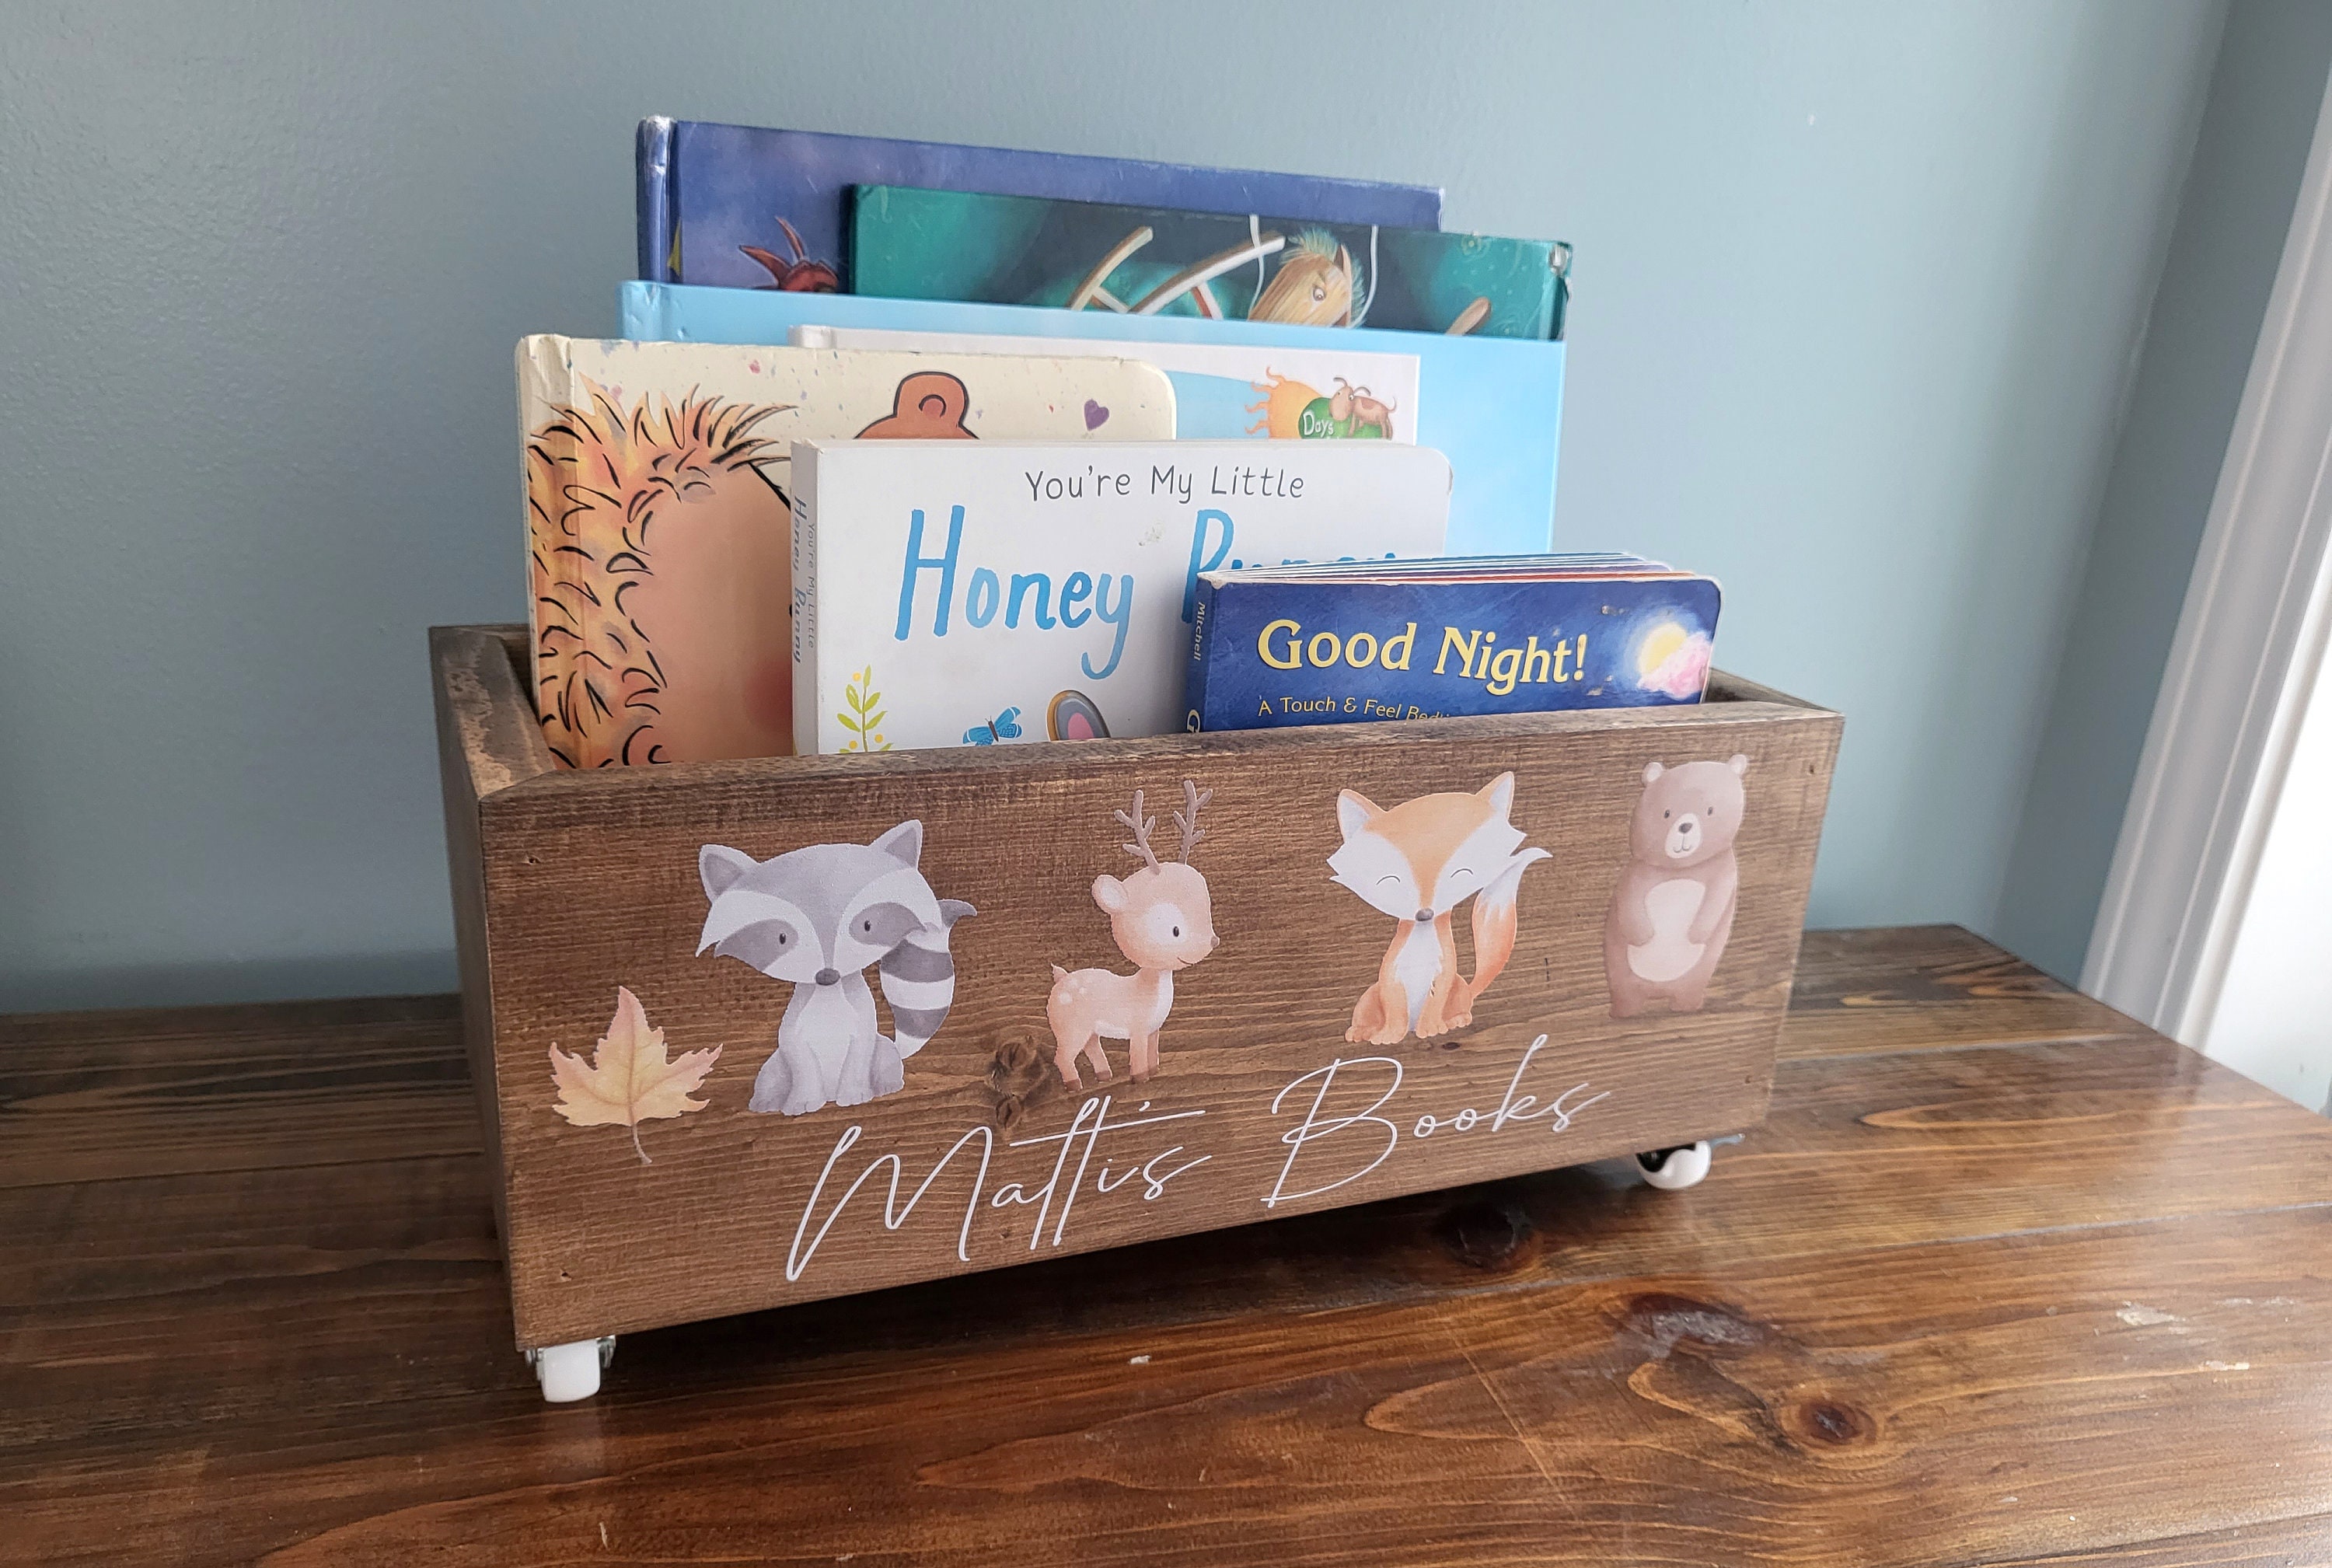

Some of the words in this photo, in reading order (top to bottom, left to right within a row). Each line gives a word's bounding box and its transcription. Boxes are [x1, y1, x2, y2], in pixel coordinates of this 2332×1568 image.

[1303, 410, 1334, 438] Days
[1025, 466, 1131, 501] You're
[1150, 465, 1193, 505] My
[1211, 465, 1304, 498] Little
[793, 495, 808, 572] Honey
[807, 522, 815, 569] You're
[806, 576, 815, 598] My
[894, 505, 1134, 680] Honey
[793, 586, 808, 664] Bunny
[807, 604, 815, 649] Little
[1193, 601, 1206, 662] Mitchell
[1257, 618, 1418, 672] Good
[1433, 626, 1589, 696] Night!
[1258, 700, 1272, 718] A
[1279, 696, 1336, 714] Touch
[1343, 697, 1358, 714] &
[1363, 699, 1402, 719] Feel
[1260, 1033, 1612, 1210] Books
